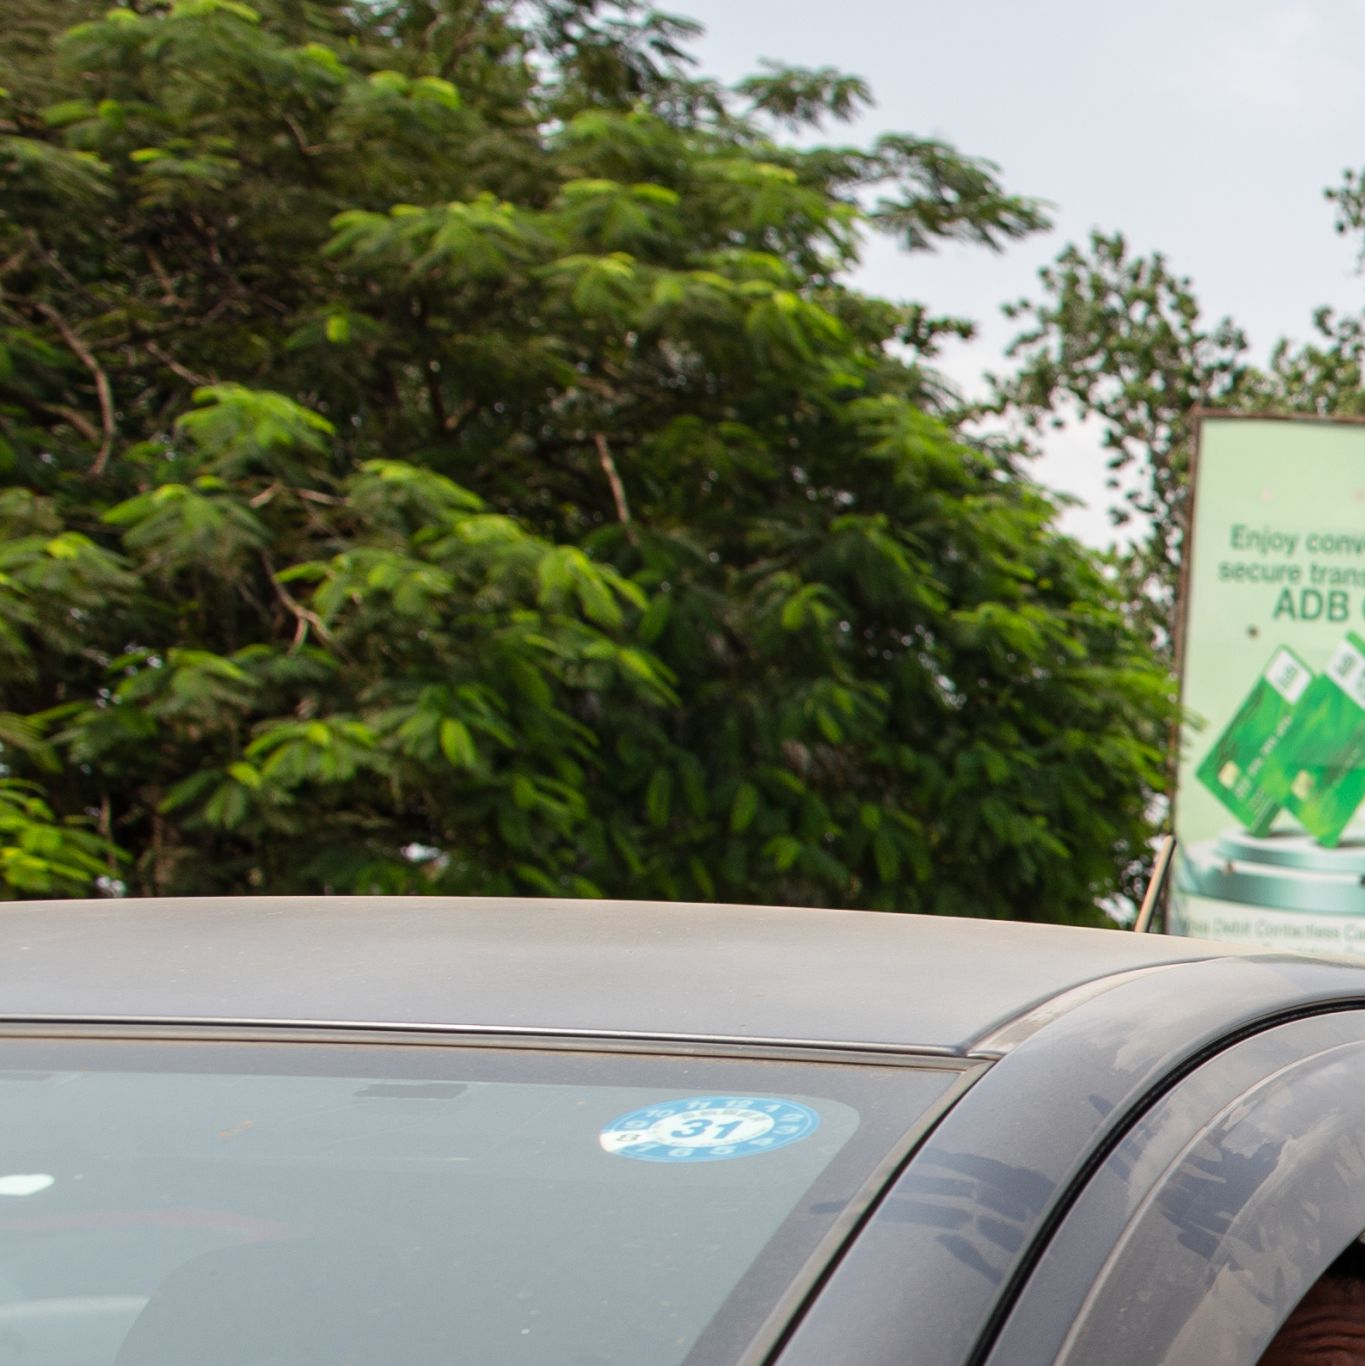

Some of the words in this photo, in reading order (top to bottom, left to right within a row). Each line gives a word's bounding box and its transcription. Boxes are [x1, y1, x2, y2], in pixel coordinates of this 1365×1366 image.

[1230, 524, 1299, 559] Enjoy
[1218, 560, 1303, 585] secure
[1272, 590, 1351, 625] ADB
[669, 1118, 745, 1140] 31
